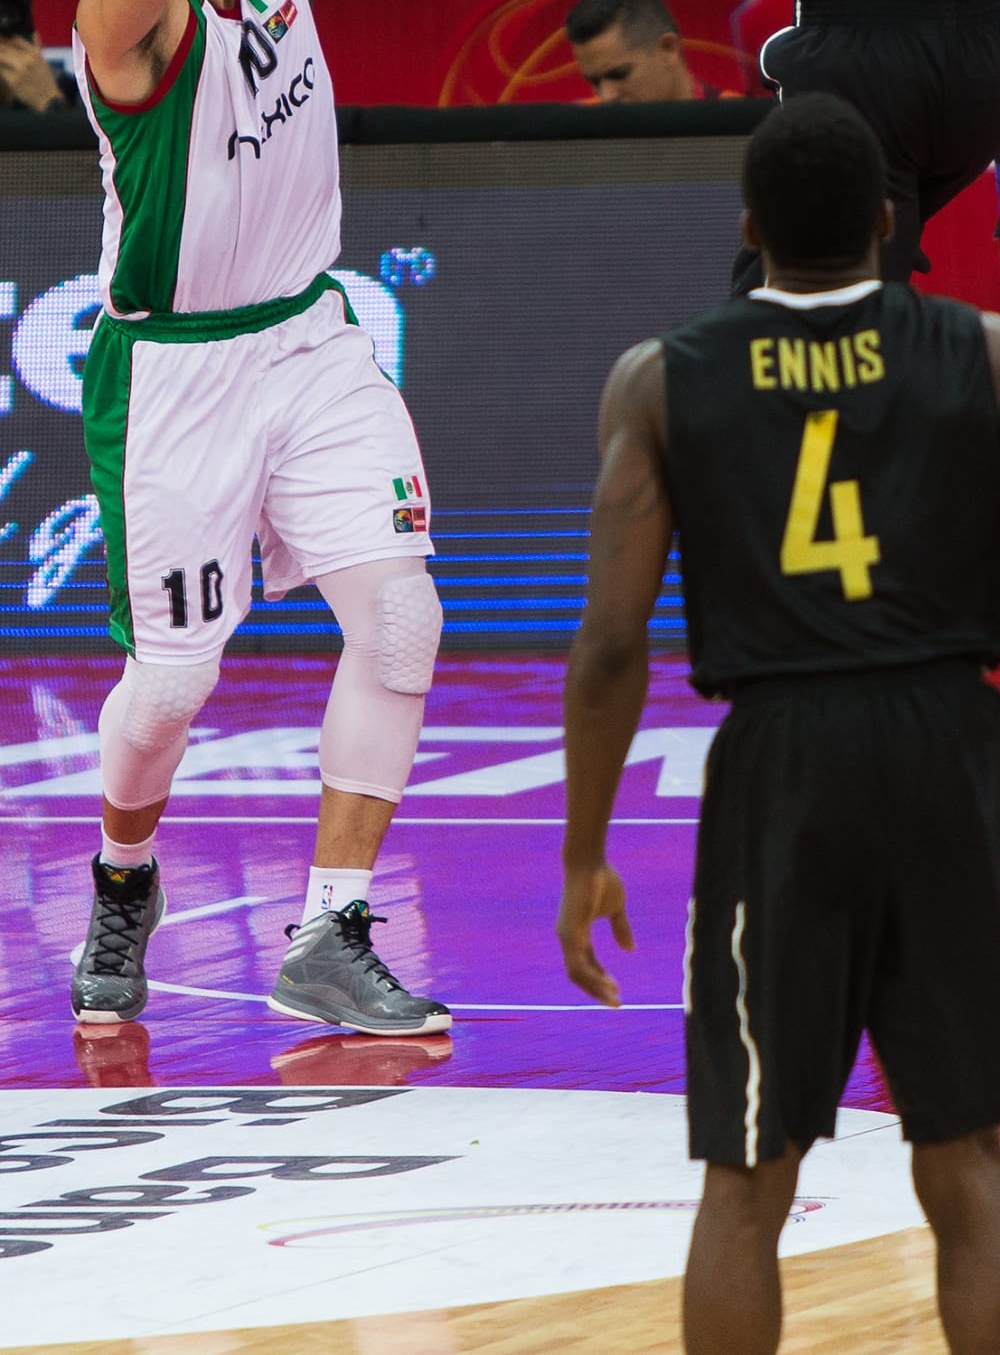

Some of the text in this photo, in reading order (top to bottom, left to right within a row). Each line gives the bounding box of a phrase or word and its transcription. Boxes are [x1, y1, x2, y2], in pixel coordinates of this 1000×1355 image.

[750, 328, 885, 392] ENNIS
[779, 409, 881, 601] 4
[161, 558, 223, 628] 10
